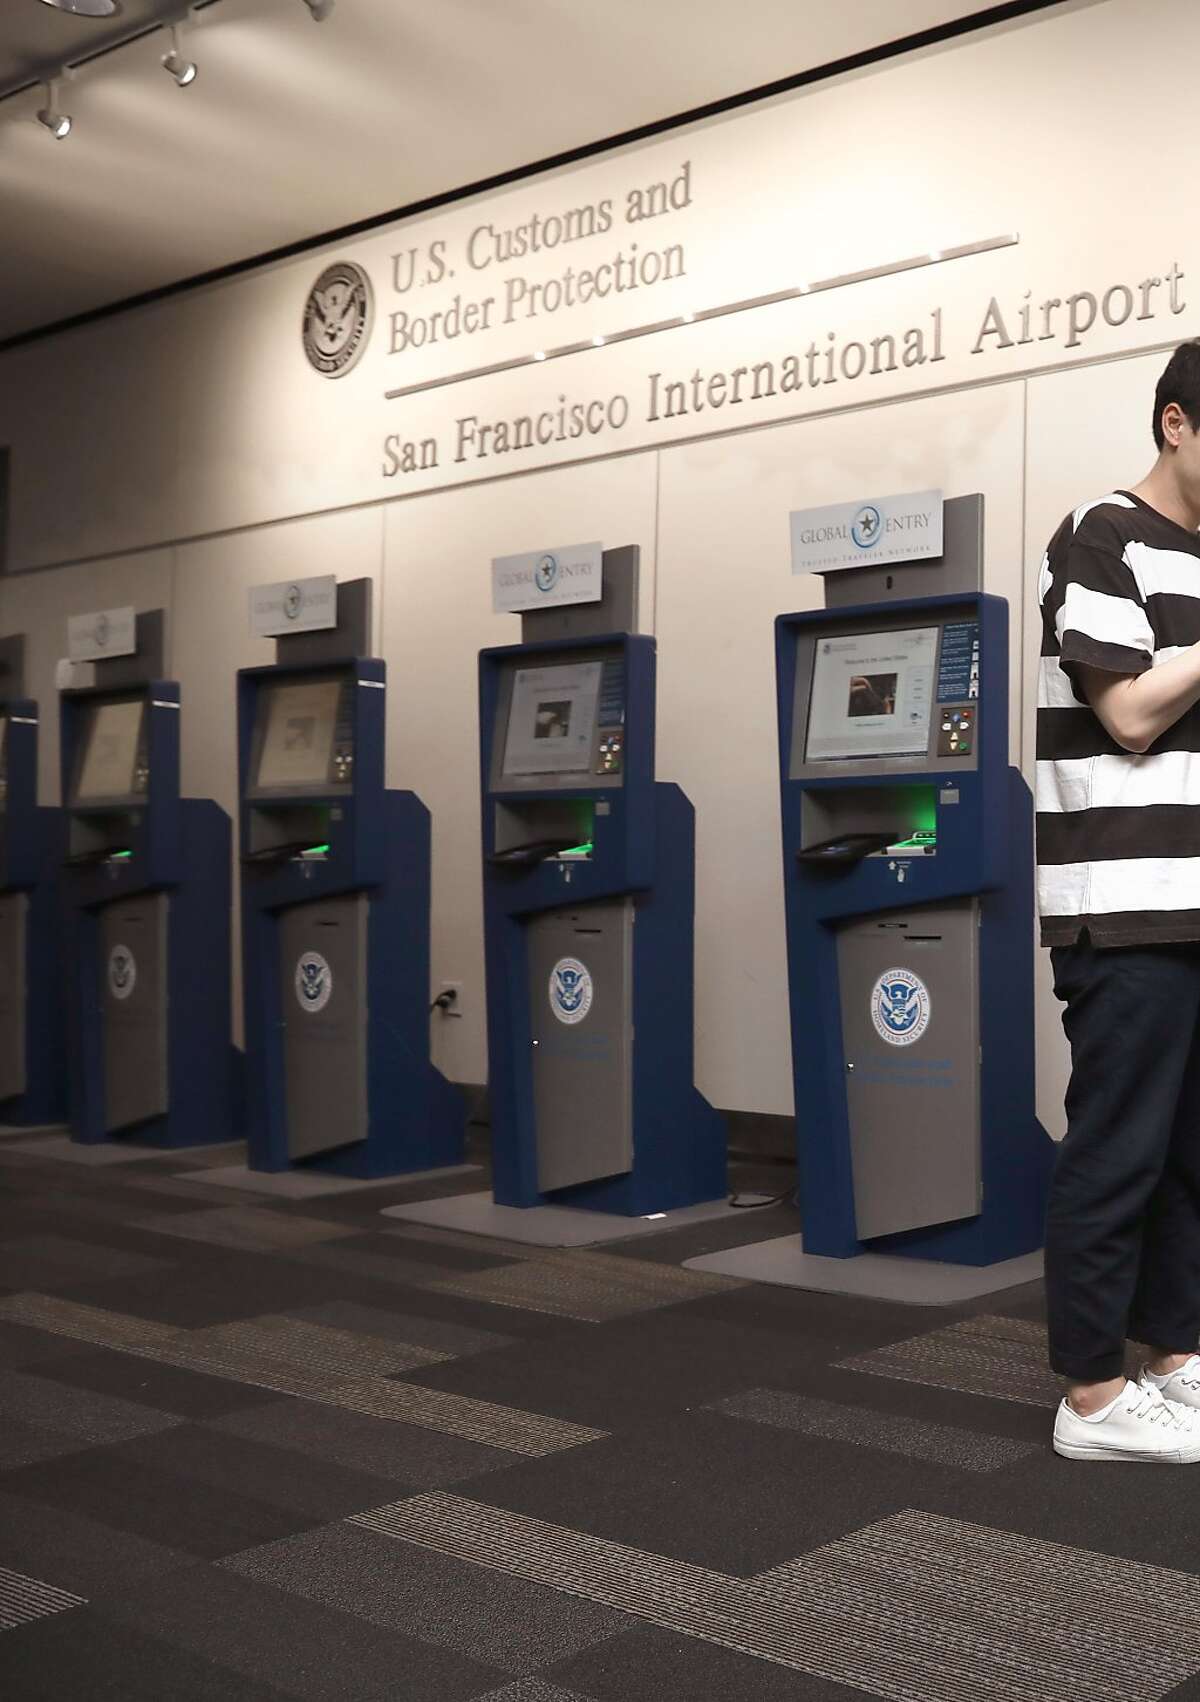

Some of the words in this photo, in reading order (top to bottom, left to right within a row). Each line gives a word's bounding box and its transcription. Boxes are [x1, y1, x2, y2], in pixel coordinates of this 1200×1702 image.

[391, 241, 455, 293] U.S.
[467, 197, 612, 270] Customs
[625, 161, 693, 224] and
[388, 295, 496, 355] Border
[503, 243, 687, 324] Protection
[382, 433, 438, 478] San
[454, 394, 629, 463] Francisco
[646, 306, 946, 422] International
[970, 261, 1187, 348] Airport
[560, 563, 593, 579] ENTRY
[801, 525, 849, 544] GLOBAL
[885, 512, 932, 533] ENTRY
